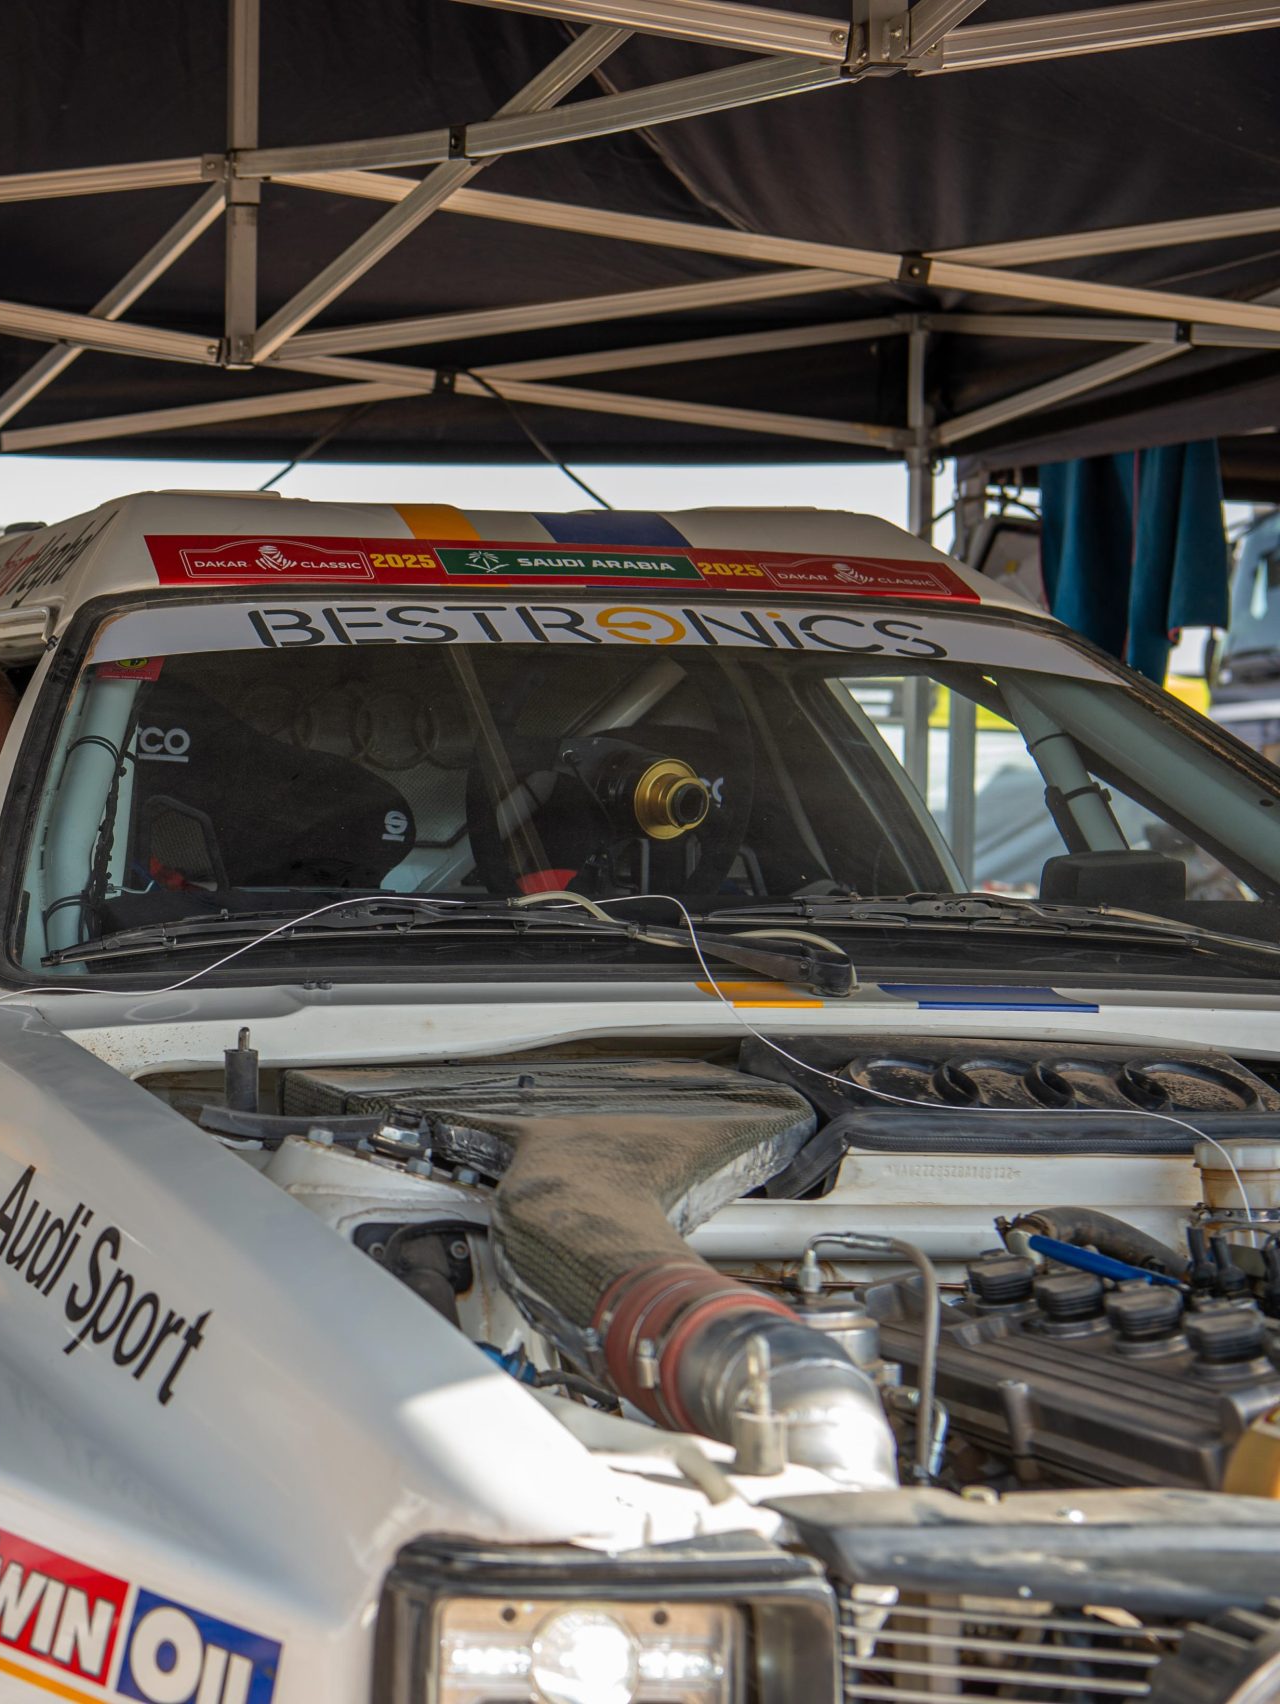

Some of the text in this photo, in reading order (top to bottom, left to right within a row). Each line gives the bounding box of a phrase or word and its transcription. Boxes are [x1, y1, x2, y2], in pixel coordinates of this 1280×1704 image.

[194, 553, 936, 587] DAKAR CLASSIC 2025 SAUDI ARABIA 2025 DAKAR CLASSIC
[64, 1226, 214, 1406] Sport
